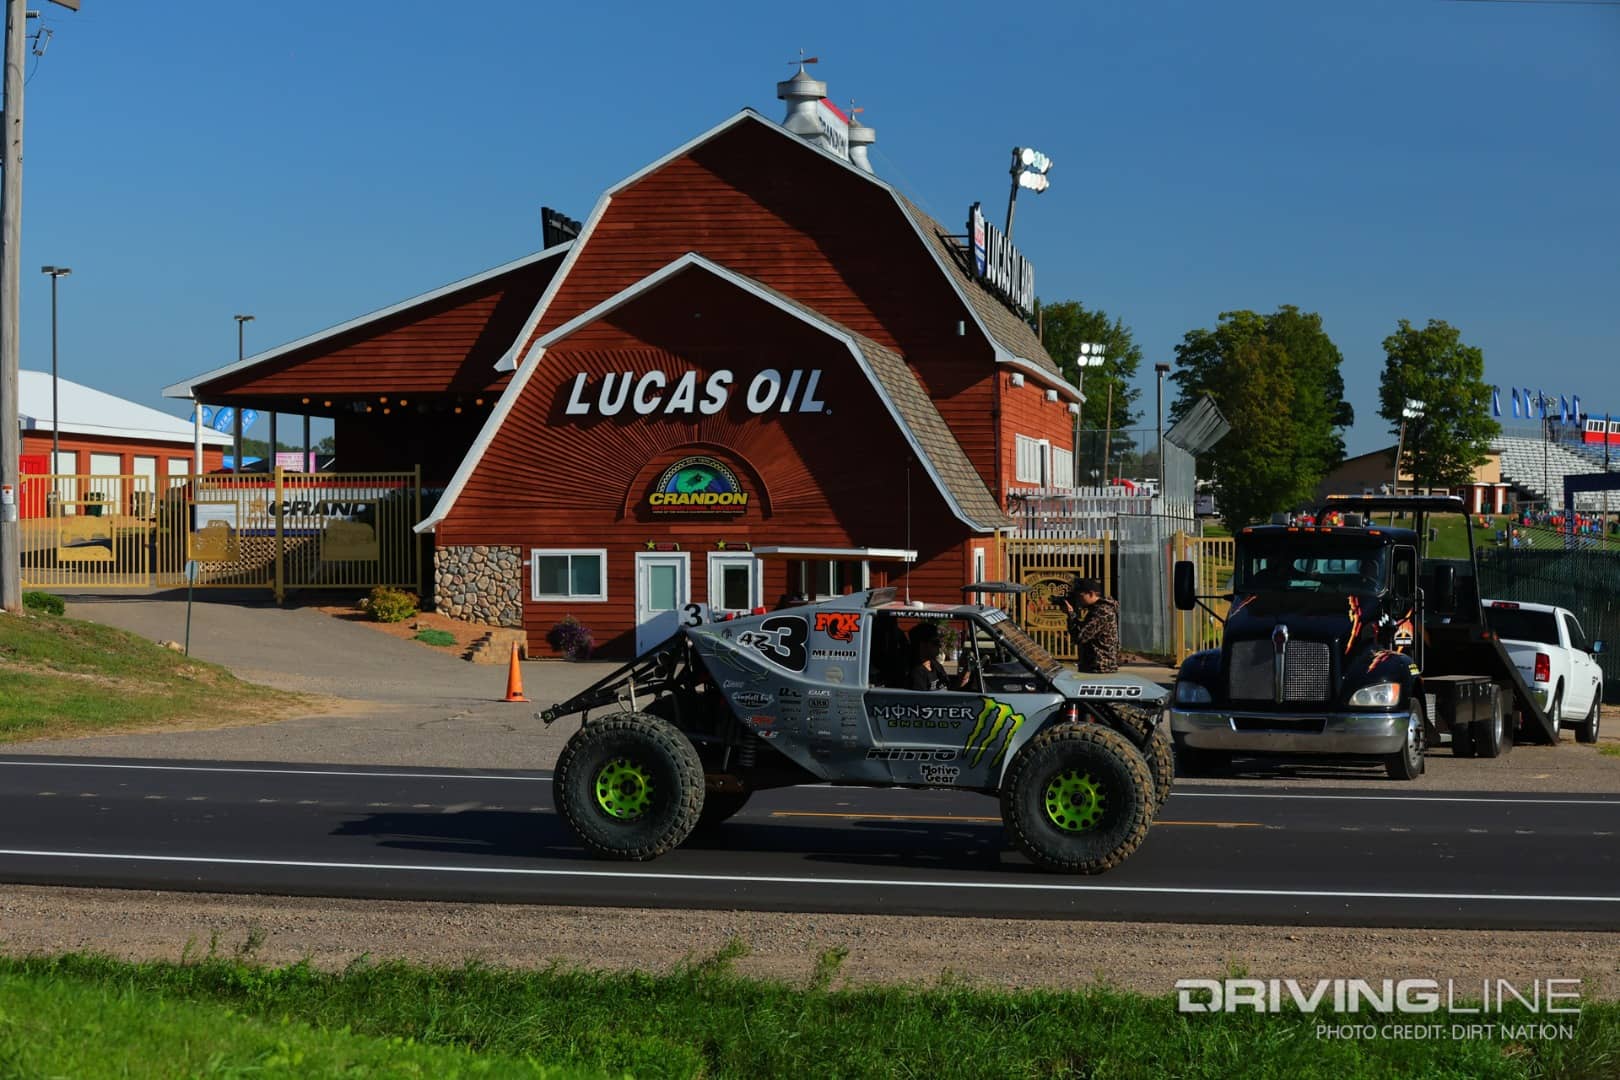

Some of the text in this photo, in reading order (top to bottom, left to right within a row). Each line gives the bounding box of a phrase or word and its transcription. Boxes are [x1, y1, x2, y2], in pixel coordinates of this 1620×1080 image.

[986, 221, 1012, 297] LUCAS
[565, 368, 825, 416] LUCAS OIL
[649, 492, 749, 506] CRANDON
[684, 604, 703, 627] 3
[814, 612, 860, 643] FOX
[760, 615, 808, 672] 3
[1078, 684, 1143, 697] NITTO
[872, 704, 976, 720] MONSTER
[887, 720, 961, 728] ENERGY
[866, 748, 958, 762] NITTO
[920, 763, 959, 777] Motive
[925, 773, 956, 783] Gear
